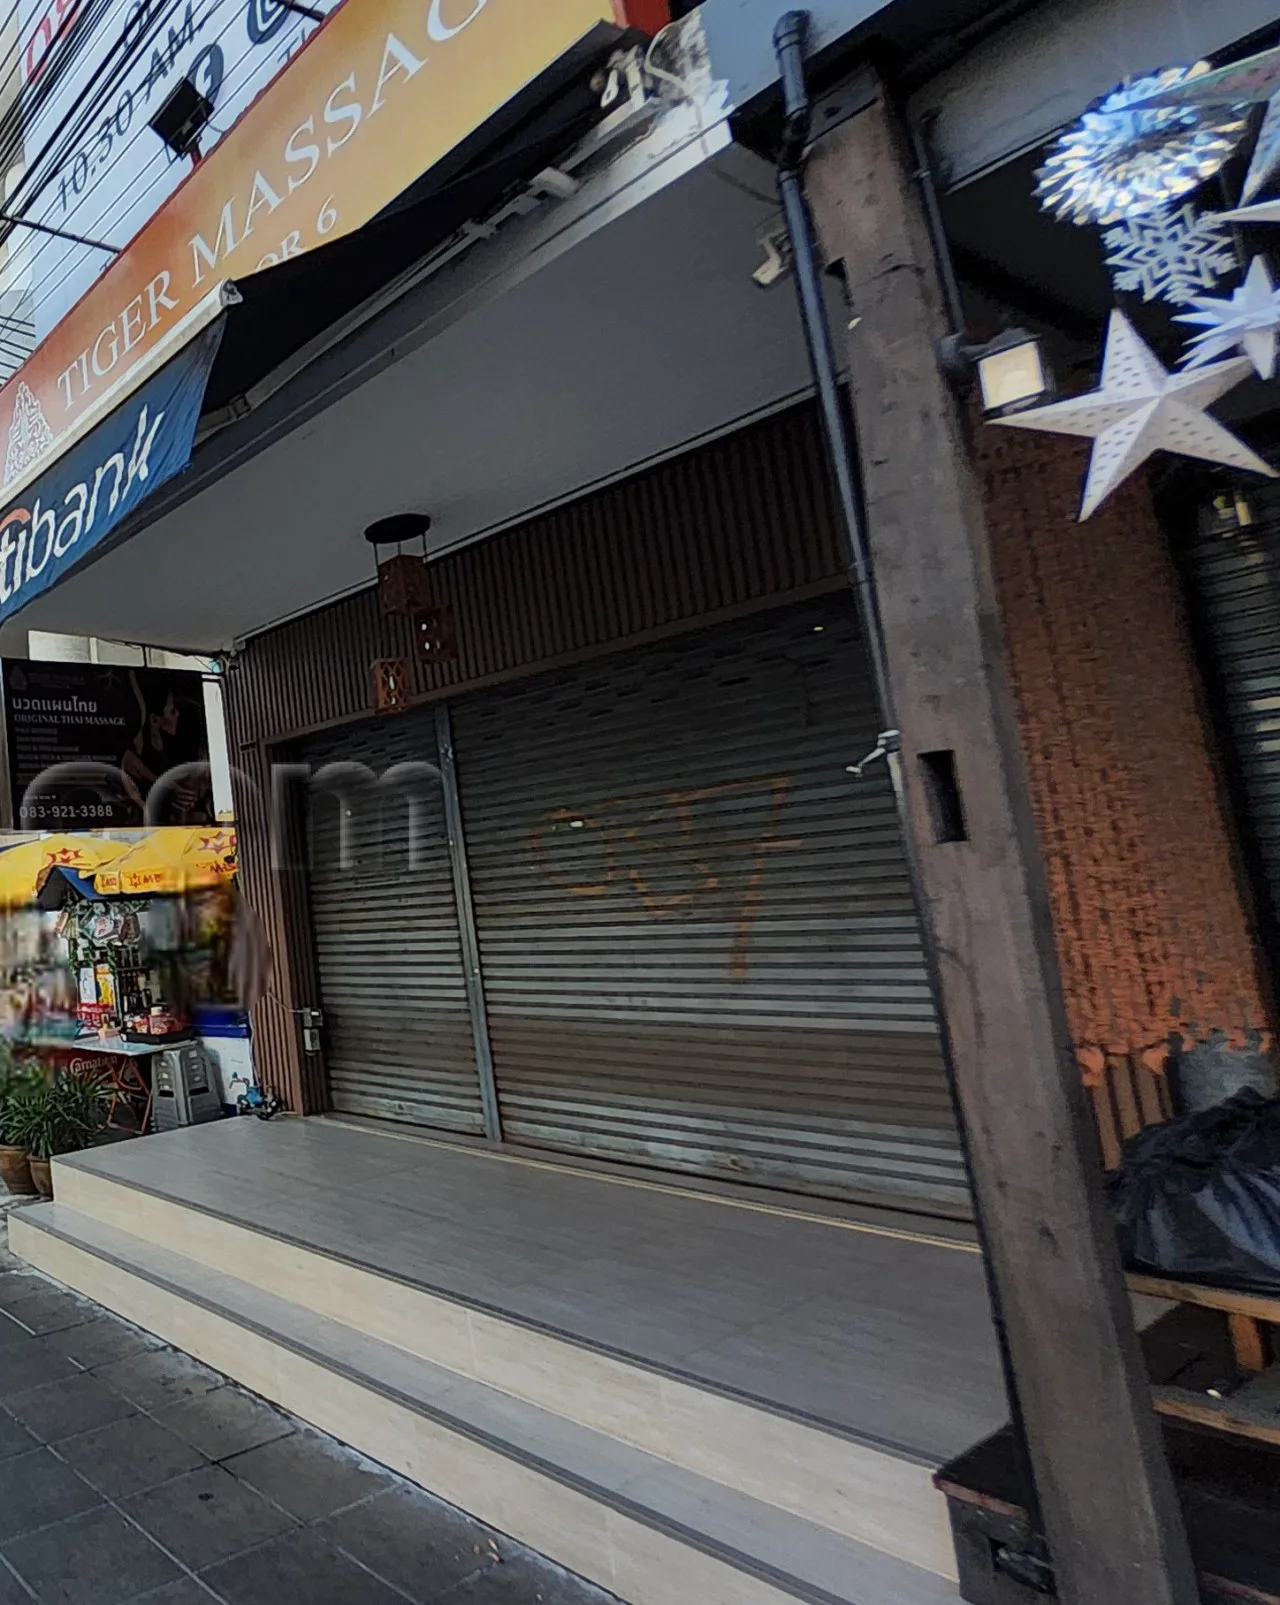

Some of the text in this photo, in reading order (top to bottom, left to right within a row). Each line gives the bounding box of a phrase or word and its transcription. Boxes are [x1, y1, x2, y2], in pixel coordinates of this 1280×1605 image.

[57, 269, 180, 412] TIGER
[12, 695, 98, 713] นวดแผนไทย
[14, 713, 127, 727] ORIGINAL THAI MASSAGE
[19, 804, 114, 819] 083-921-3388
